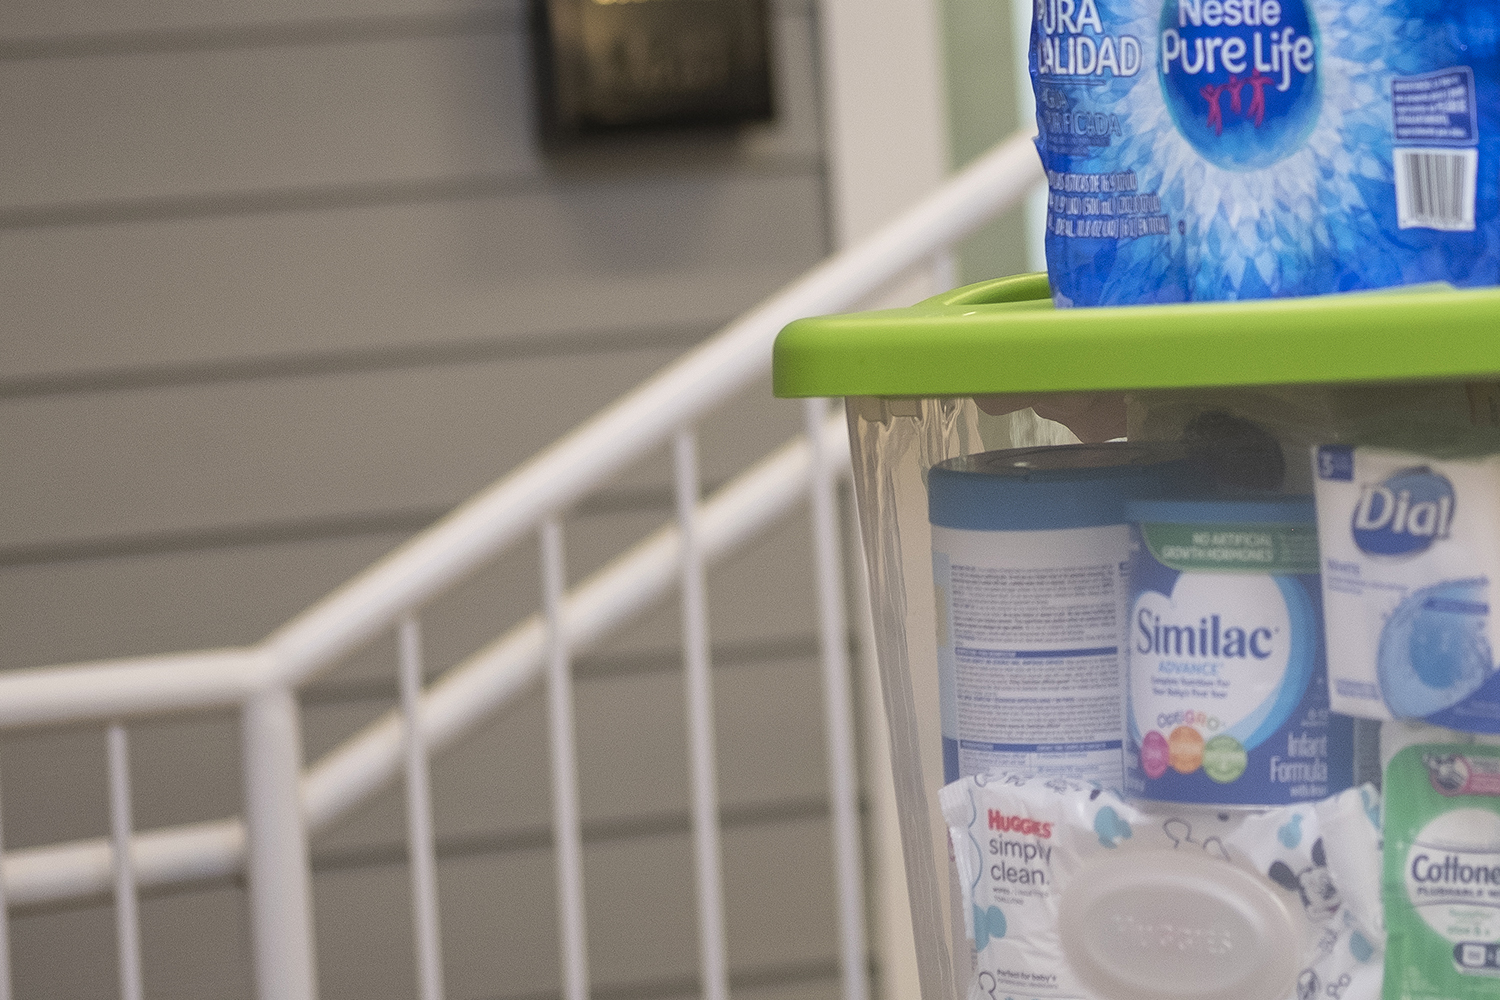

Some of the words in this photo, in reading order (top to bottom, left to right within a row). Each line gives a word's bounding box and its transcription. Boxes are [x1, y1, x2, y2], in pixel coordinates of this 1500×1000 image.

[1161, 29, 1247, 76] Pure
[1253, 27, 1316, 92] Life
[1356, 485, 1451, 537] Dial
[1137, 607, 1273, 661] Similac
[1287, 731, 1327, 758] Infant
[1270, 757, 1328, 783] Formula
[988, 808, 1052, 839] HUGGIES
[989, 834, 1052, 866] simply
